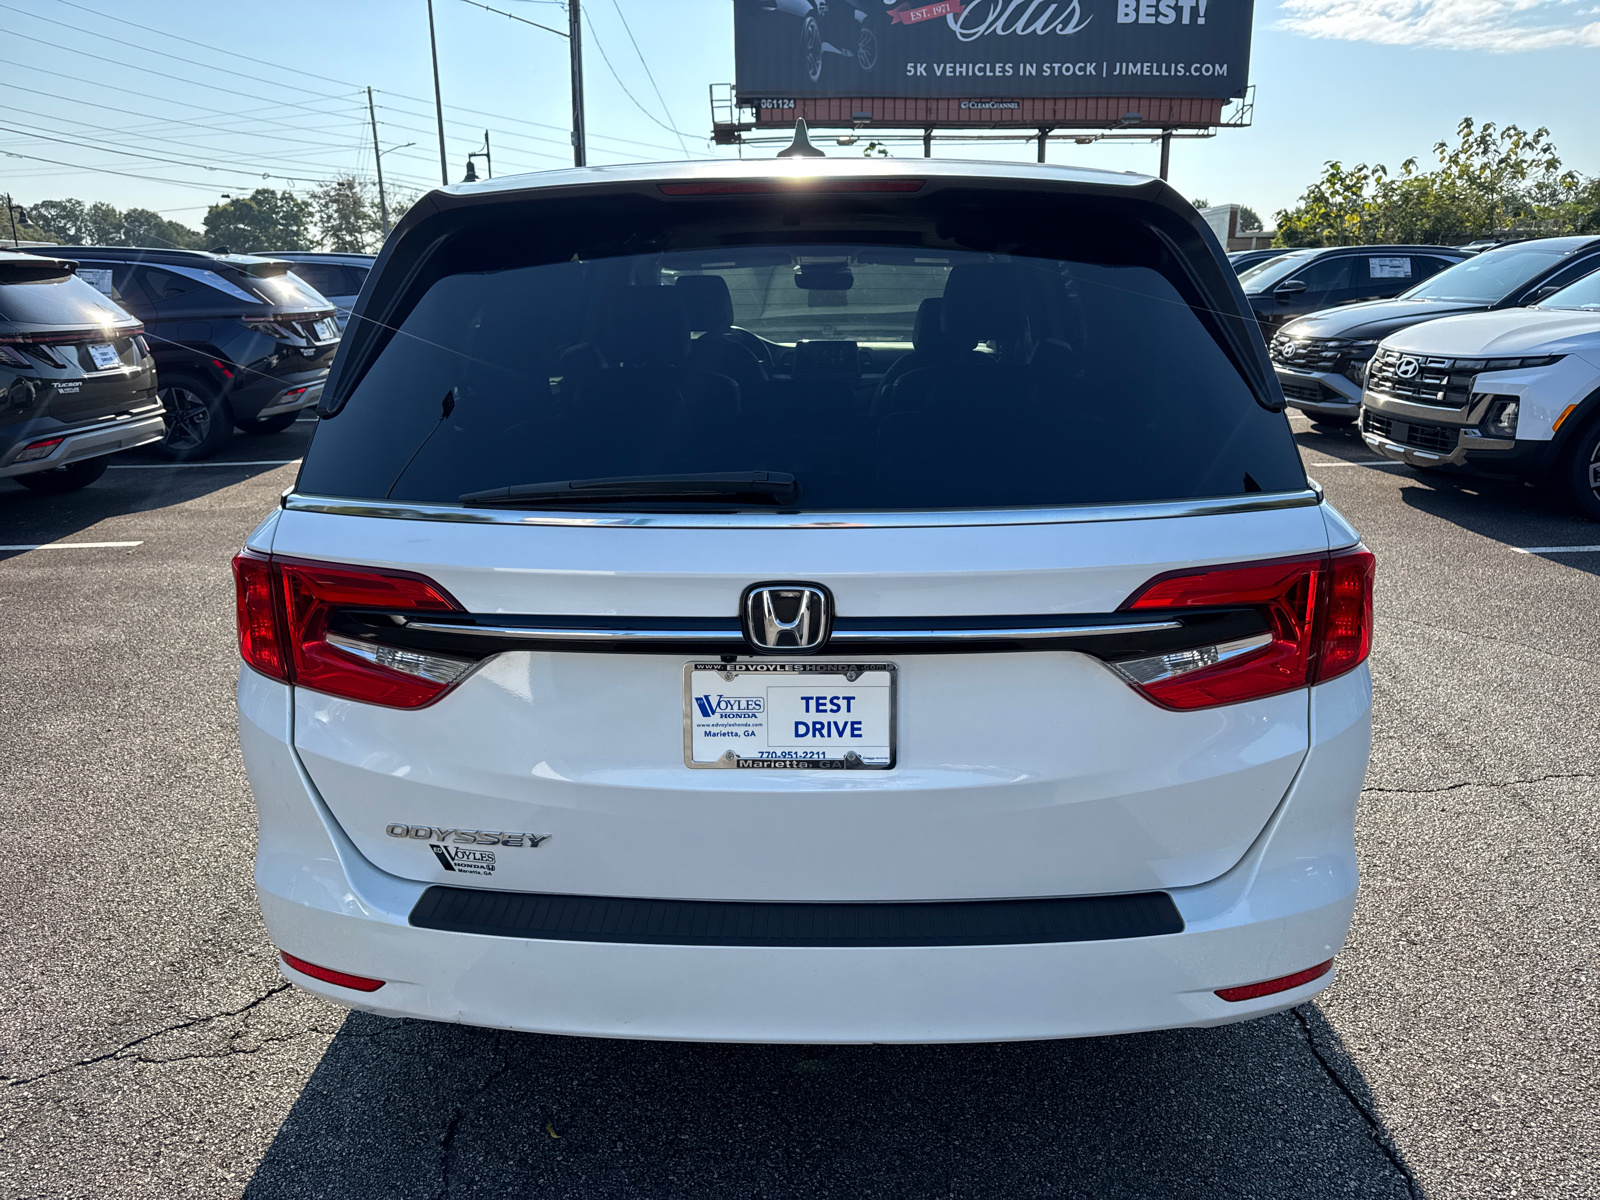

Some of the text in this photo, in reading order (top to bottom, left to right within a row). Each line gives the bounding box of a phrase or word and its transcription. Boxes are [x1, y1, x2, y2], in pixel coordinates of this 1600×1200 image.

[910, 3, 950, 21] EST. 1971
[1116, 0, 1208, 25] BEST!
[906, 63, 927, 76] 5K
[933, 63, 1013, 76] VEHICLES
[1019, 63, 1037, 76] IN
[1042, 62, 1097, 76] STOCK
[1113, 62, 1228, 76] JIMELLIS.COM
[703, 694, 762, 716] VOYLES
[800, 696, 856, 713] TEST
[696, 721, 763, 729] www.edvoyleshonda.com
[794, 721, 863, 738] DRIVE
[704, 730, 741, 738] Marietta,
[758, 751, 826, 759] 770-951-2211
[739, 760, 843, 769] Marietta, GA
[385, 822, 552, 848] ODYSSEY
[443, 844, 494, 862] VOYLES
